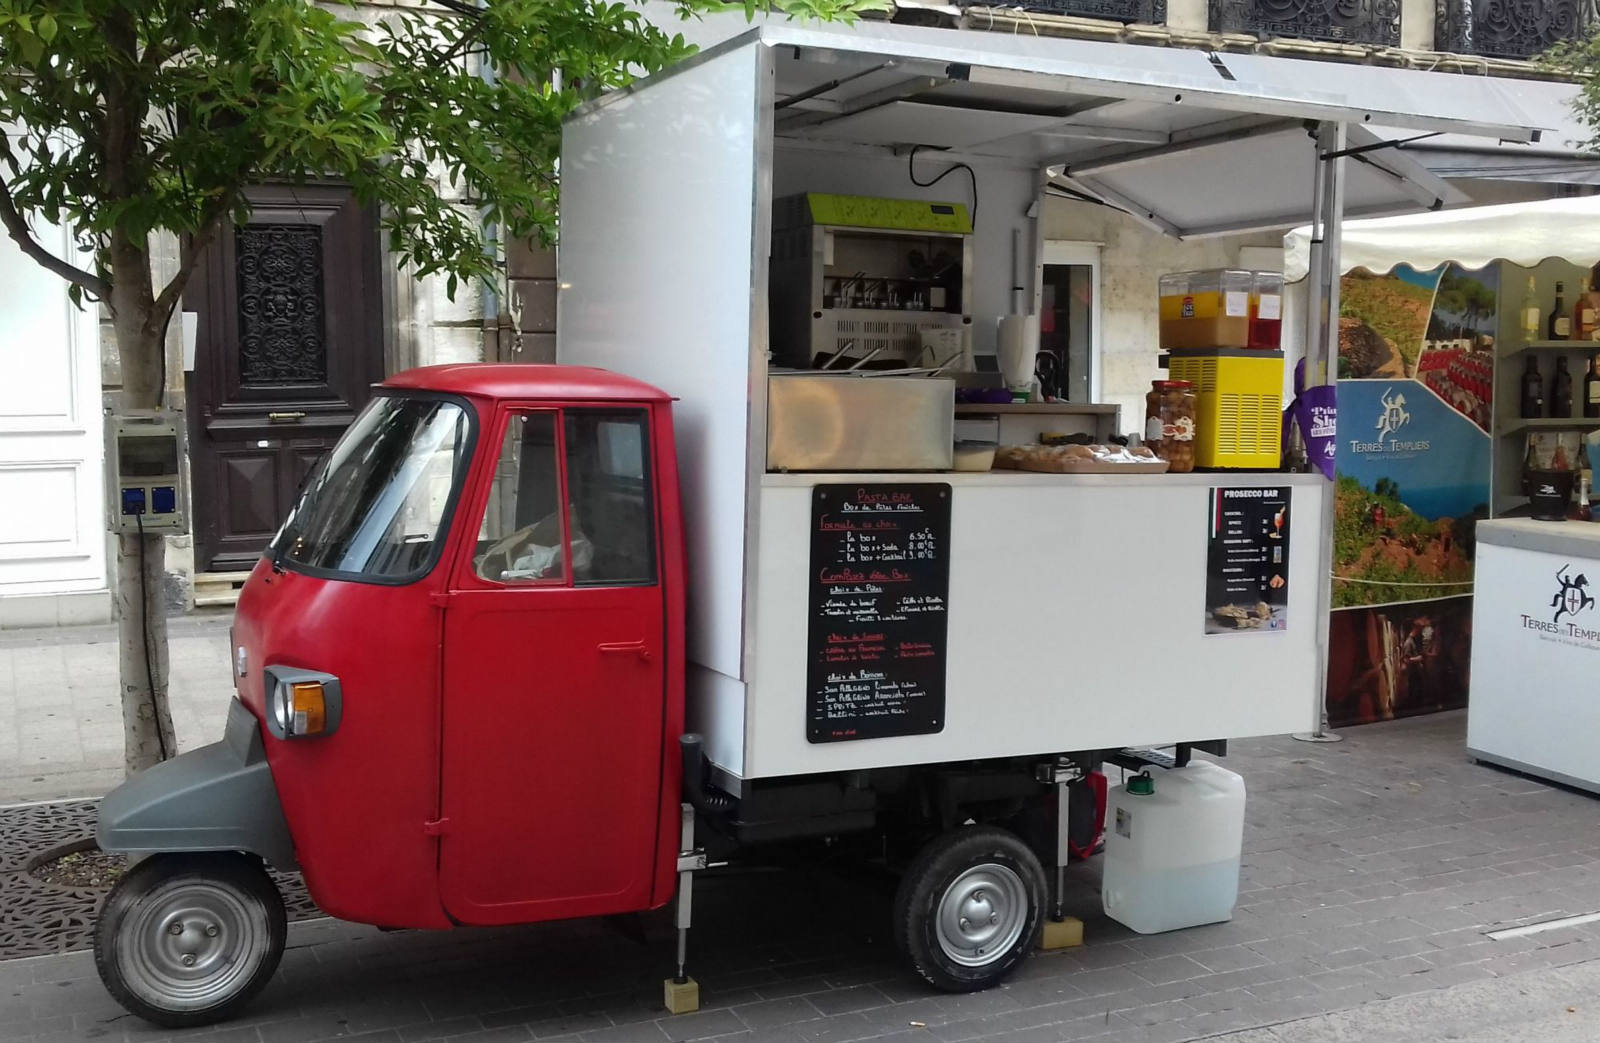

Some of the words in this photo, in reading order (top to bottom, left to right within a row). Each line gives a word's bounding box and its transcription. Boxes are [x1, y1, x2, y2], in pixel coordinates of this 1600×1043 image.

[1350, 440, 1383, 453] TERRES
[1224, 489, 1262, 498] PROSECCO
[1263, 489, 1278, 497] BAR
[1520, 614, 1559, 634] TERRES
